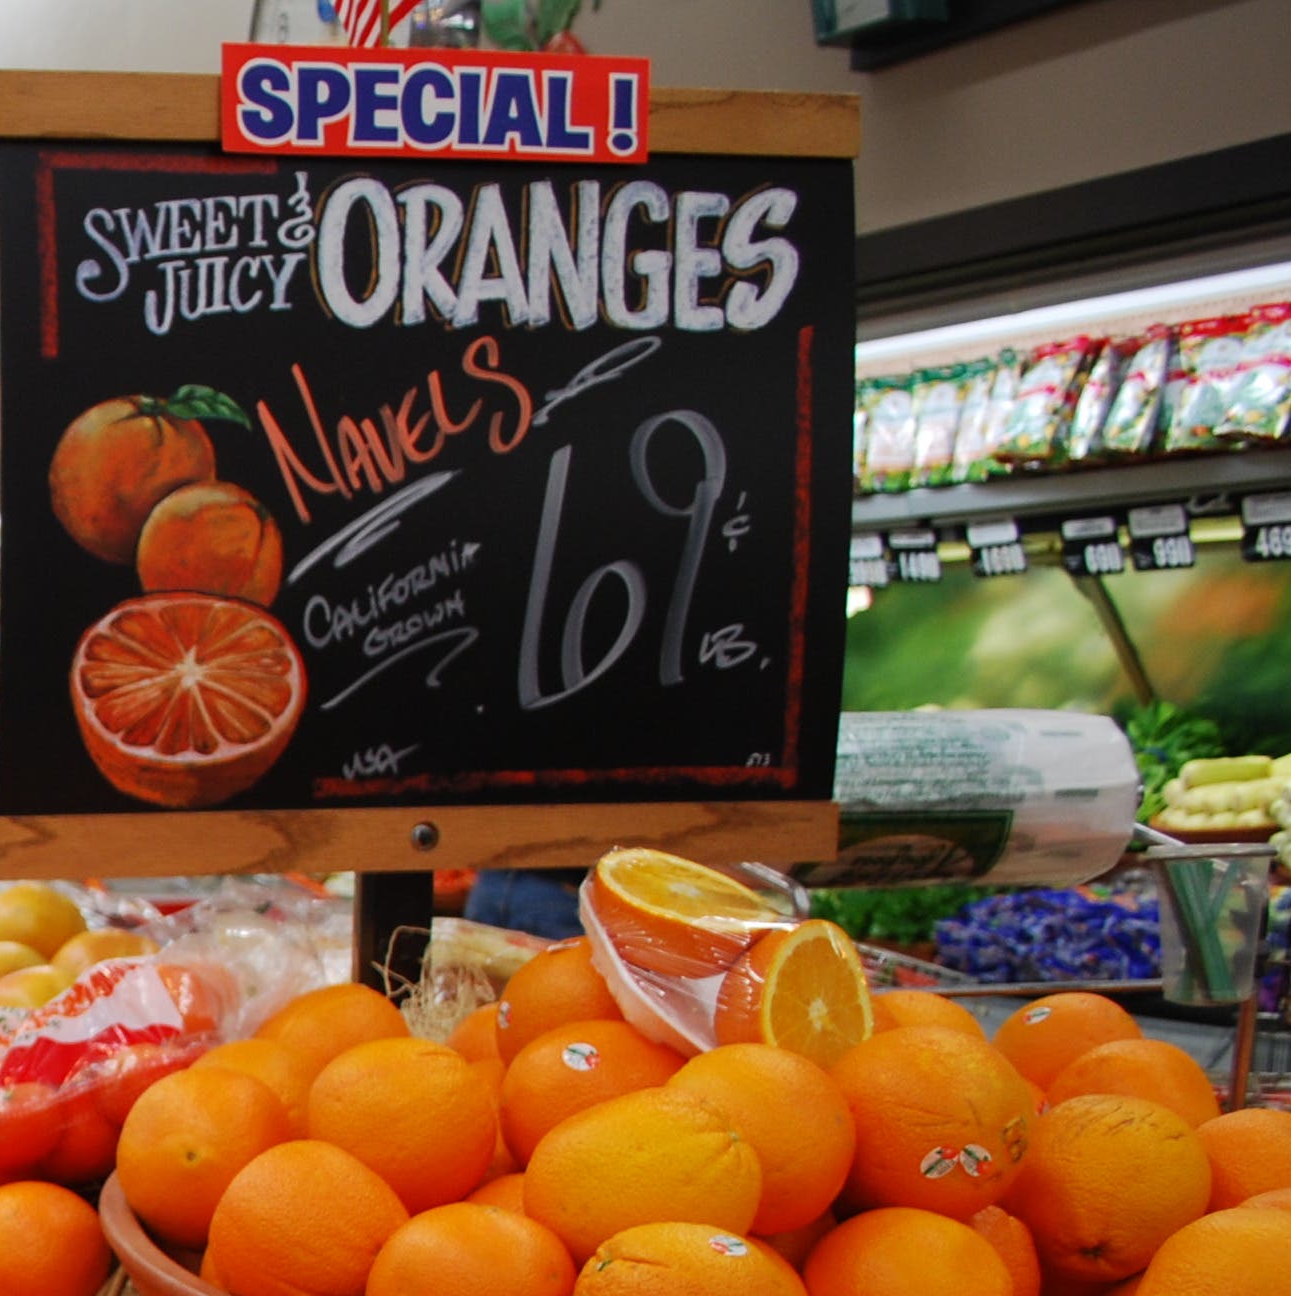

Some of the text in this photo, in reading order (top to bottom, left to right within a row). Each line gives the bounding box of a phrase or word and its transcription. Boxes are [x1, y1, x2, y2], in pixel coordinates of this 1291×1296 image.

[237, 56, 595, 156] SPECIAL
[75, 194, 279, 303] SWEET
[143, 253, 308, 336] JUICY
[318, 176, 801, 332] ORANGES
[257, 335, 534, 524] NAVELS
[303, 538, 481, 648] CALIFORNIA
[363, 589, 465, 656] GROWN
